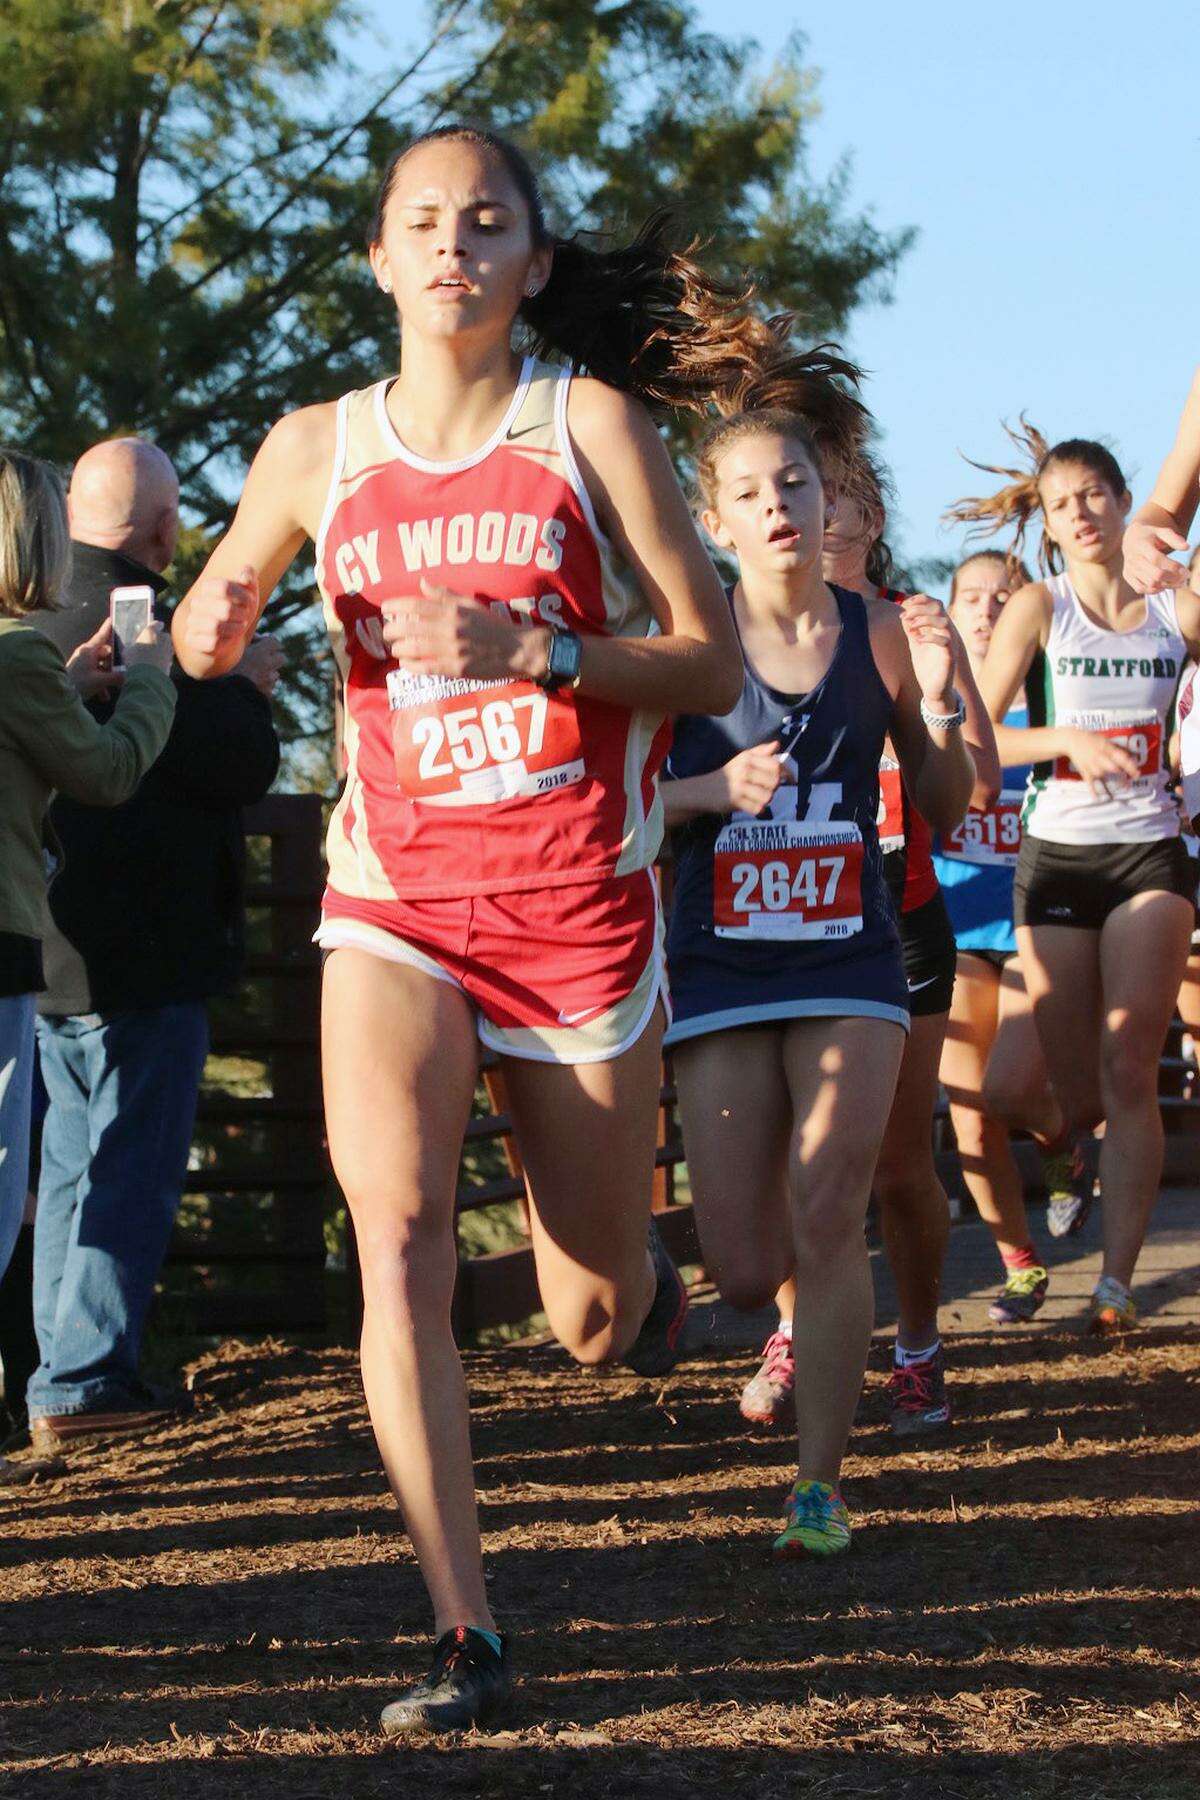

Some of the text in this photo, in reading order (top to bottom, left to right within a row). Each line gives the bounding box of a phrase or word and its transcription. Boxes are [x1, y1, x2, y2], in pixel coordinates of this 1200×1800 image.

[335, 511, 567, 595] CY WOODS
[1056, 657, 1177, 679] STRATFORD
[412, 693, 549, 780] 2567
[537, 772, 568, 789] 2018
[751, 825, 788, 840] STATE
[716, 839, 747, 853] CROSS
[747, 838, 789, 852] COUNTRY
[731, 856, 846, 913] 2647
[824, 924, 848, 935] 2018
